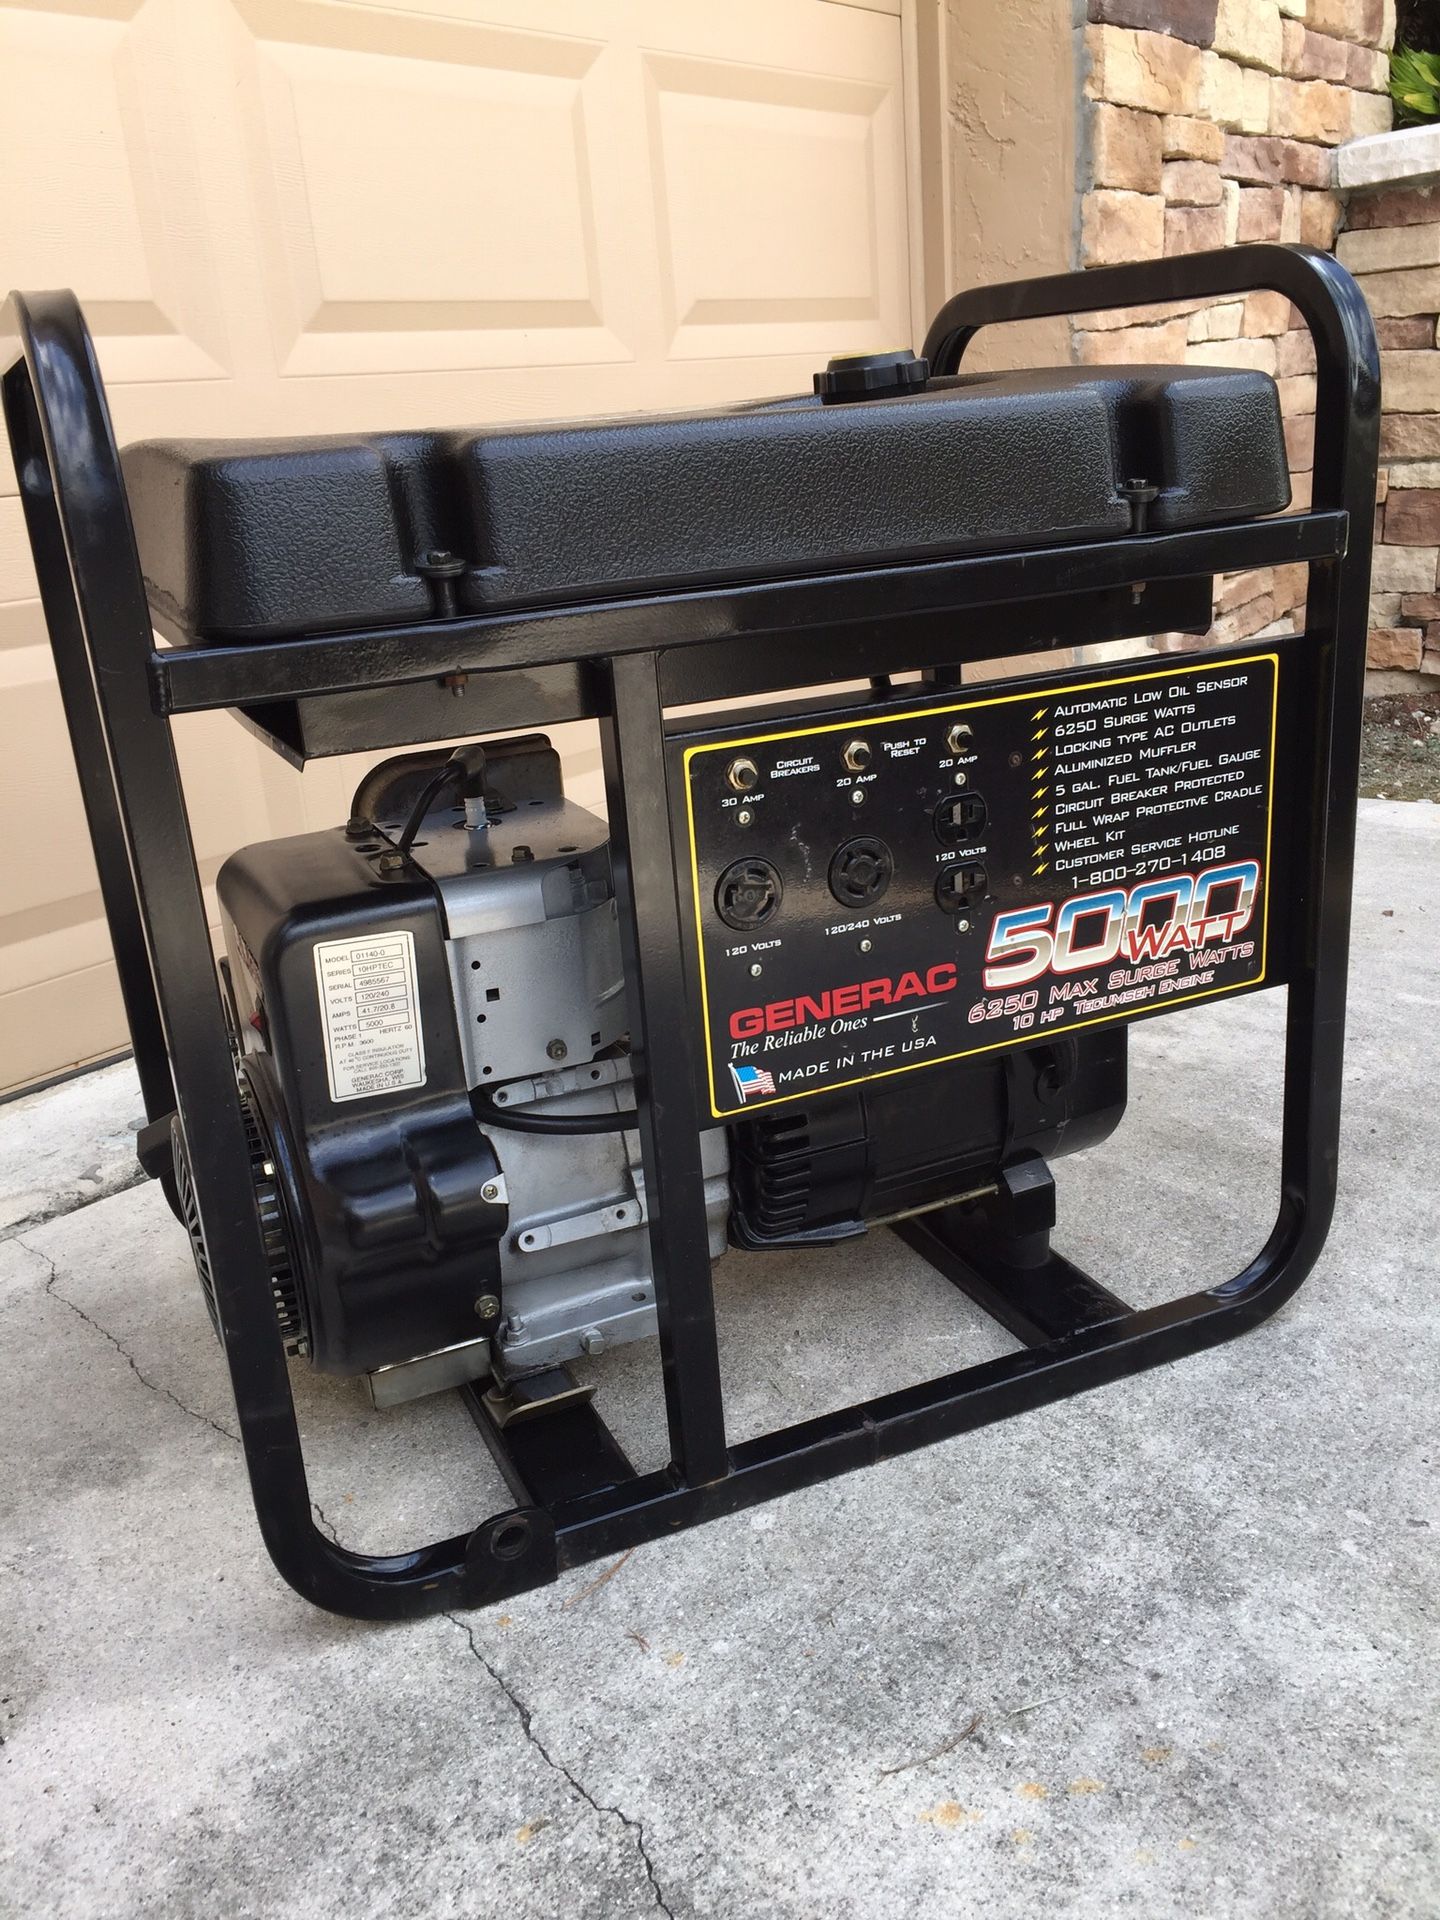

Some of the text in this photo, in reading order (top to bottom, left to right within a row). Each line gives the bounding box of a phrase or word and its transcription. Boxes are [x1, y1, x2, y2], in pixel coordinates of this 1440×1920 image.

[1054, 676, 1248, 718] AUTOMATIC LOW OIL SENSOR
[1055, 704, 1195, 737] 6250 SURGE WATTS
[883, 737, 927, 752] PUSH TO
[1055, 715, 1236, 756] LOCKING TYPE AC OUTLETS
[776, 756, 814, 769] CIRCUIT
[890, 747, 920, 758] RESET
[939, 755, 978, 768] 20 AMP
[1054, 741, 1196, 776] ALUMINIZED MUFFLER
[770, 764, 820, 779] BREAKERS
[836, 774, 877, 787] 20 AMP
[1056, 749, 1261, 796] 5 GAL. FUEL TANK/FUEL GAUGE
[721, 794, 765, 807] 30 AMP
[1056, 771, 1245, 815] CIRCUIT BREAKER PROTECTED
[1055, 785, 1263, 834] FULL WRAP PROTECTIVE CRADLE
[1055, 830, 1126, 853] WHEEL KIT
[1056, 825, 1240, 871] CUSTOMER SERVICE HOTLINE
[935, 847, 987, 862] 120 VOLTS
[1072, 846, 1226, 888] 1-800-270-1408
[825, 913, 902, 936] 120/240 VOLTS
[982, 858, 1262, 991] 5000
[725, 939, 782, 956] 120 VOLTS
[1127, 912, 1245, 965] WATT
[326, 950, 385, 963] MODEL 01140-0
[327, 962, 393, 977] SERIES 10HPTEC
[329, 983, 352, 991] SERIAL
[968, 942, 1254, 1024] 6250 MAX SURGE WATTS
[361, 990, 389, 1000] 120/240
[729, 963, 957, 1039] GENERAC
[1012, 970, 1214, 1030] 10 HP TECUMSEH ENGINE
[333, 1024, 357, 1032] WATTS
[334, 1034, 356, 1042] PHASE
[380, 1026, 402, 1034] HERTZ
[731, 1016, 868, 1059] The Reliable Ones
[778, 1036, 937, 1083] MADE IN THE USA
